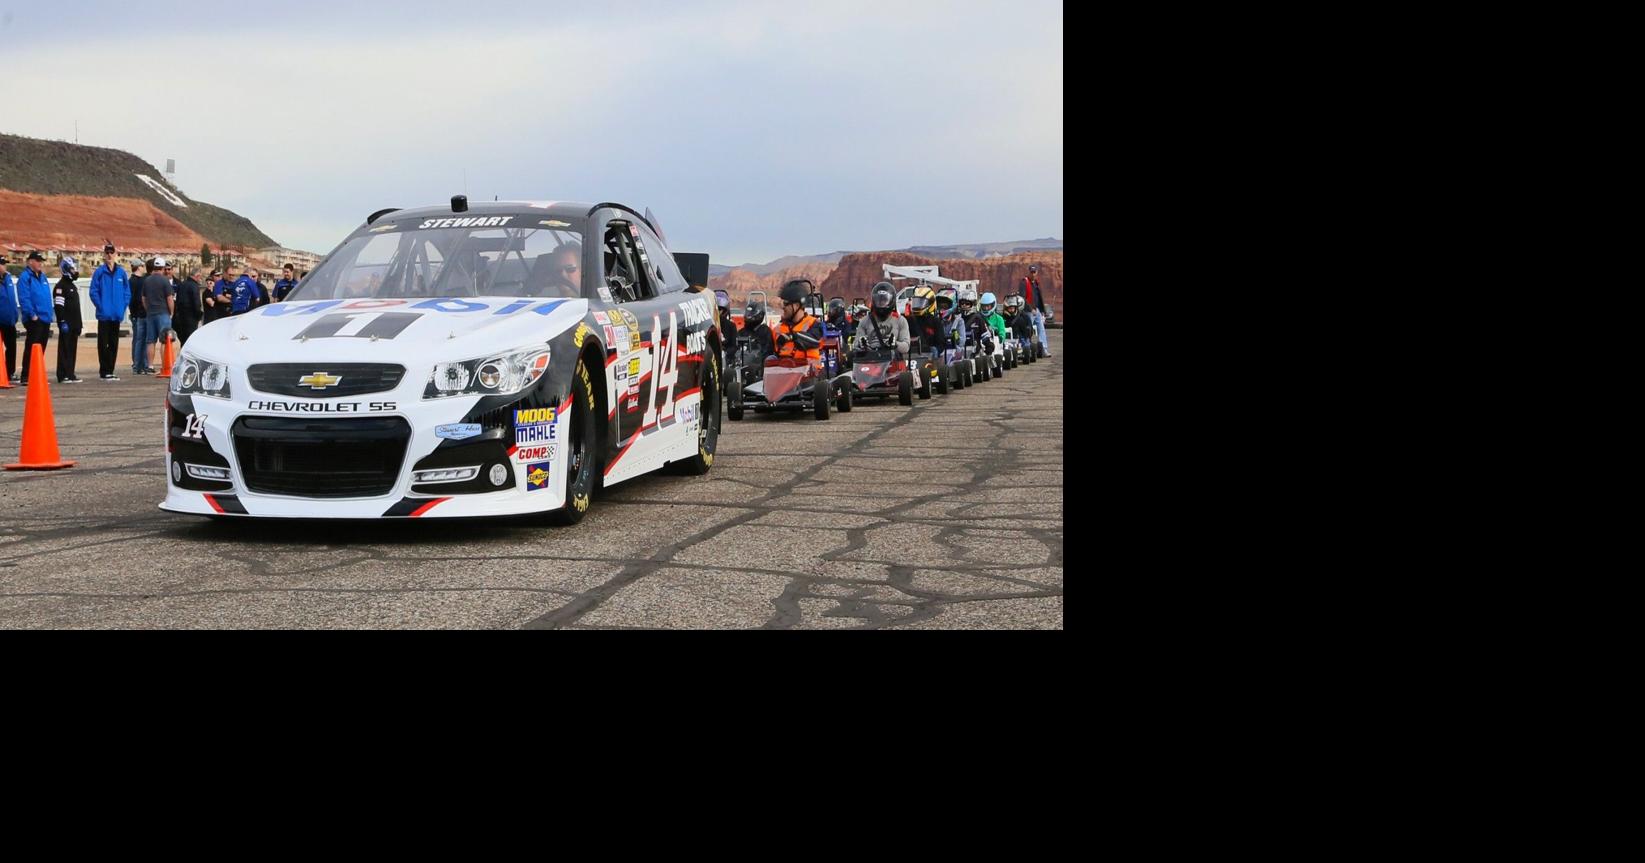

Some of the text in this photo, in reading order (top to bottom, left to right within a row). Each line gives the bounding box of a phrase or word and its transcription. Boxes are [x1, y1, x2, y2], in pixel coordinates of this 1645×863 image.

[419, 216, 513, 229] STEWART
[642, 311, 679, 429] 14
[248, 400, 397, 412] CHEVROLET SS
[516, 407, 556, 424] MOOG
[181, 412, 208, 438] 14
[516, 425, 556, 443] MAHLE
[518, 446, 547, 460] COMP
